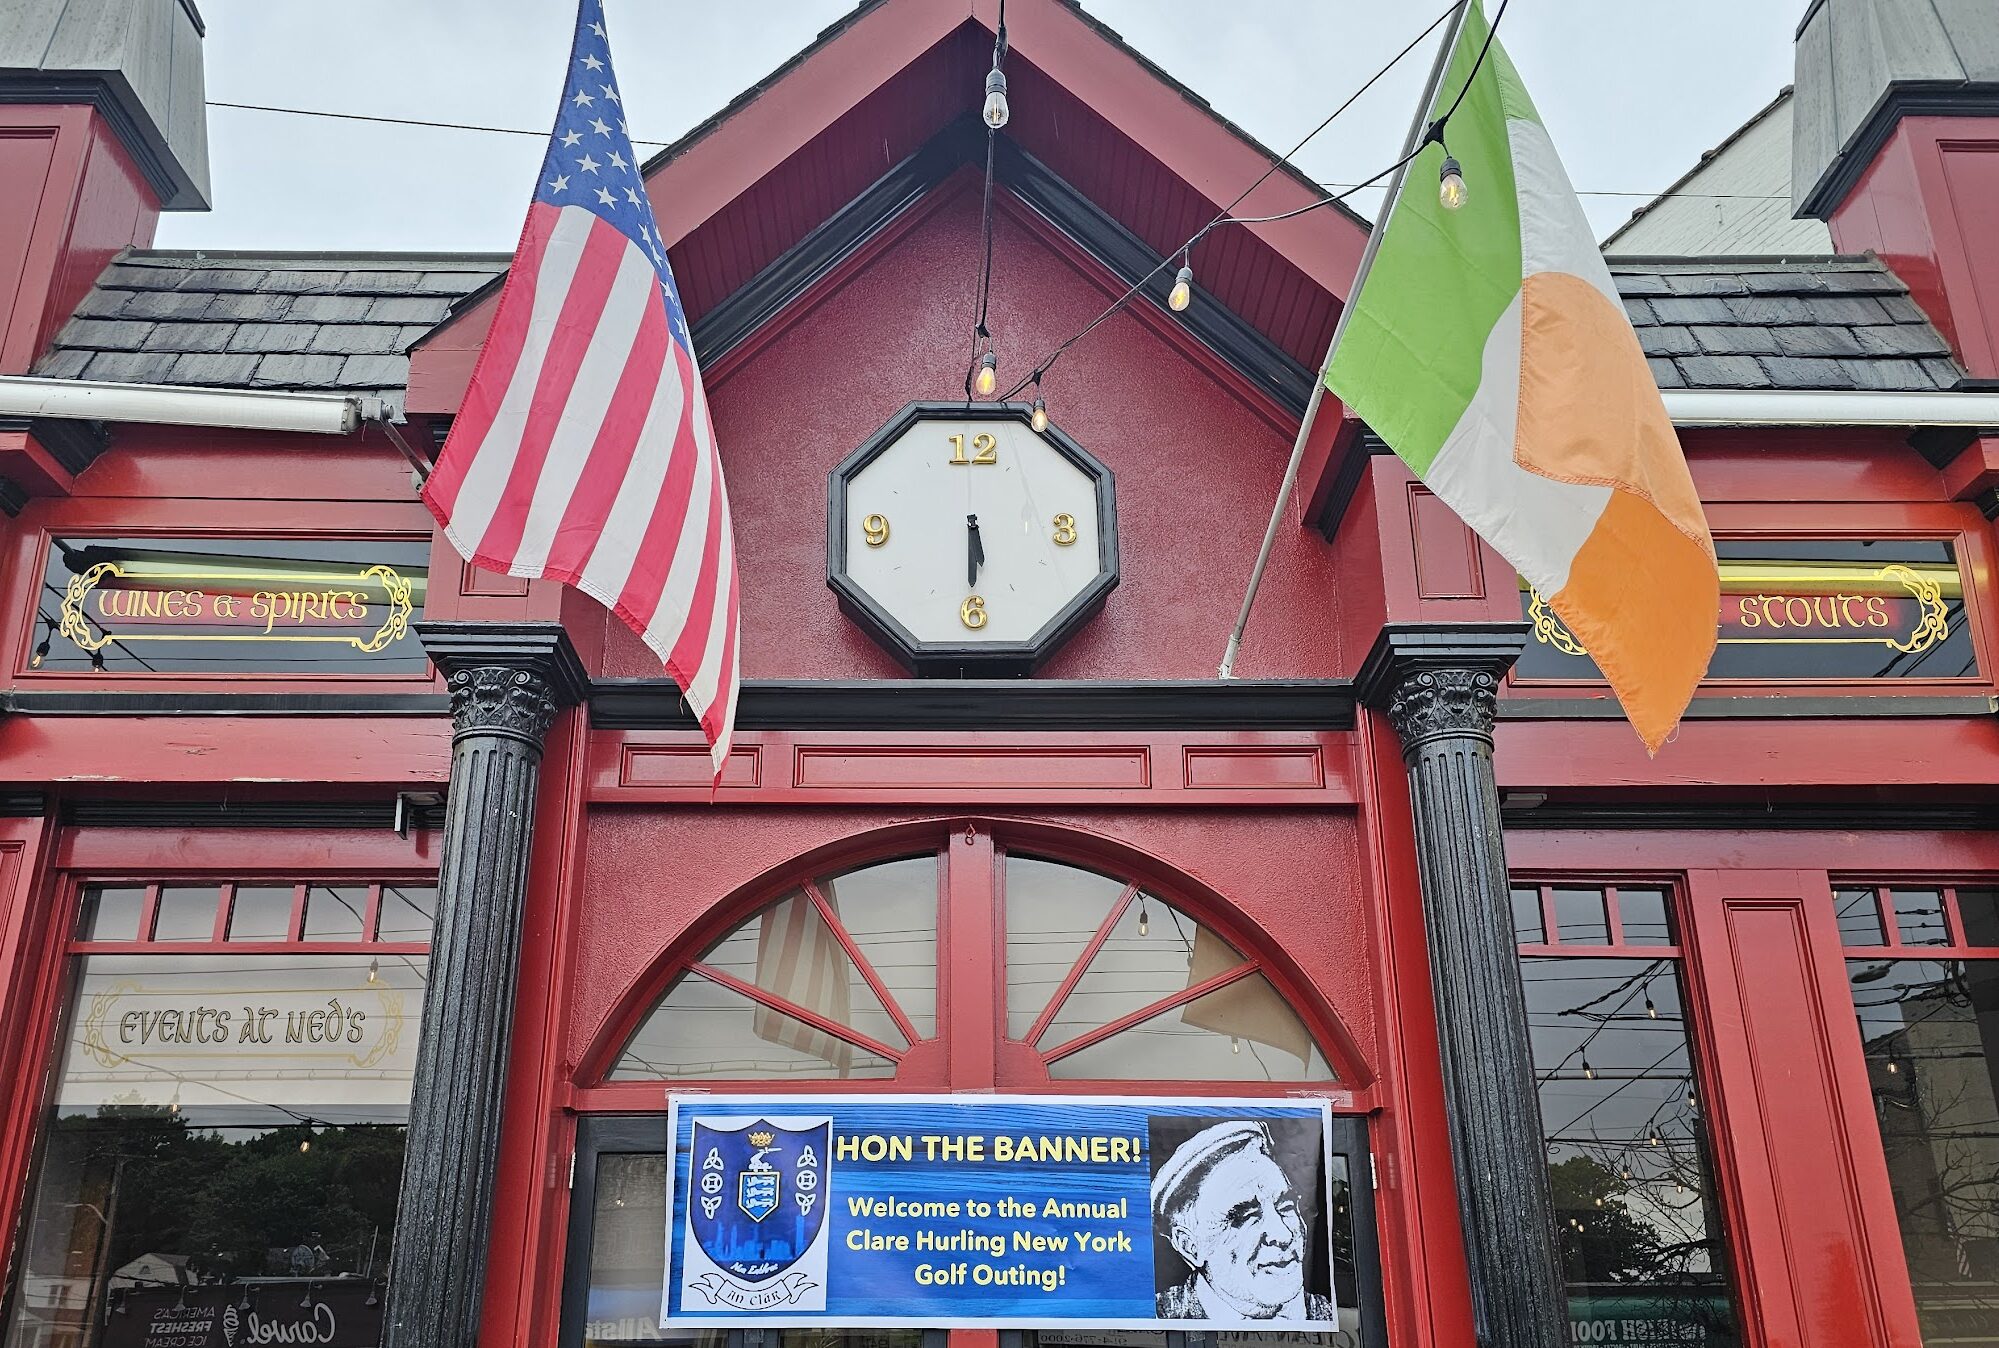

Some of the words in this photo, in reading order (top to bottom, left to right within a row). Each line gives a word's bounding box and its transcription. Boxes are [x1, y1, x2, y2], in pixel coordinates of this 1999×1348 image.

[948, 433, 997, 465] 12
[862, 513, 890, 548] 9
[1052, 512, 1078, 547] 3
[99, 590, 204, 618] WINES
[213, 595, 241, 618] &
[250, 589, 369, 634] SPIRITS
[960, 595, 988, 630] 6
[1739, 593, 1889, 628] STOUTS
[120, 1006, 232, 1045] EVENTS
[239, 1006, 279, 1044] AT
[837, 1135, 912, 1162] HON
[921, 1135, 985, 1162] THE
[994, 1136, 1141, 1163] BANNER!
[848, 1196, 960, 1218] Welcome
[966, 1199, 991, 1218] to
[997, 1197, 1036, 1218] the
[1042, 1197, 1127, 1219] Annual
[846, 1229, 909, 1251] Clare
[916, 1230, 1005, 1257] Hurling
[1013, 1231, 1068, 1252] New
[1074, 1231, 1132, 1252] York
[914, 1263, 967, 1286] Golf
[973, 1264, 1066, 1291] Outing!
